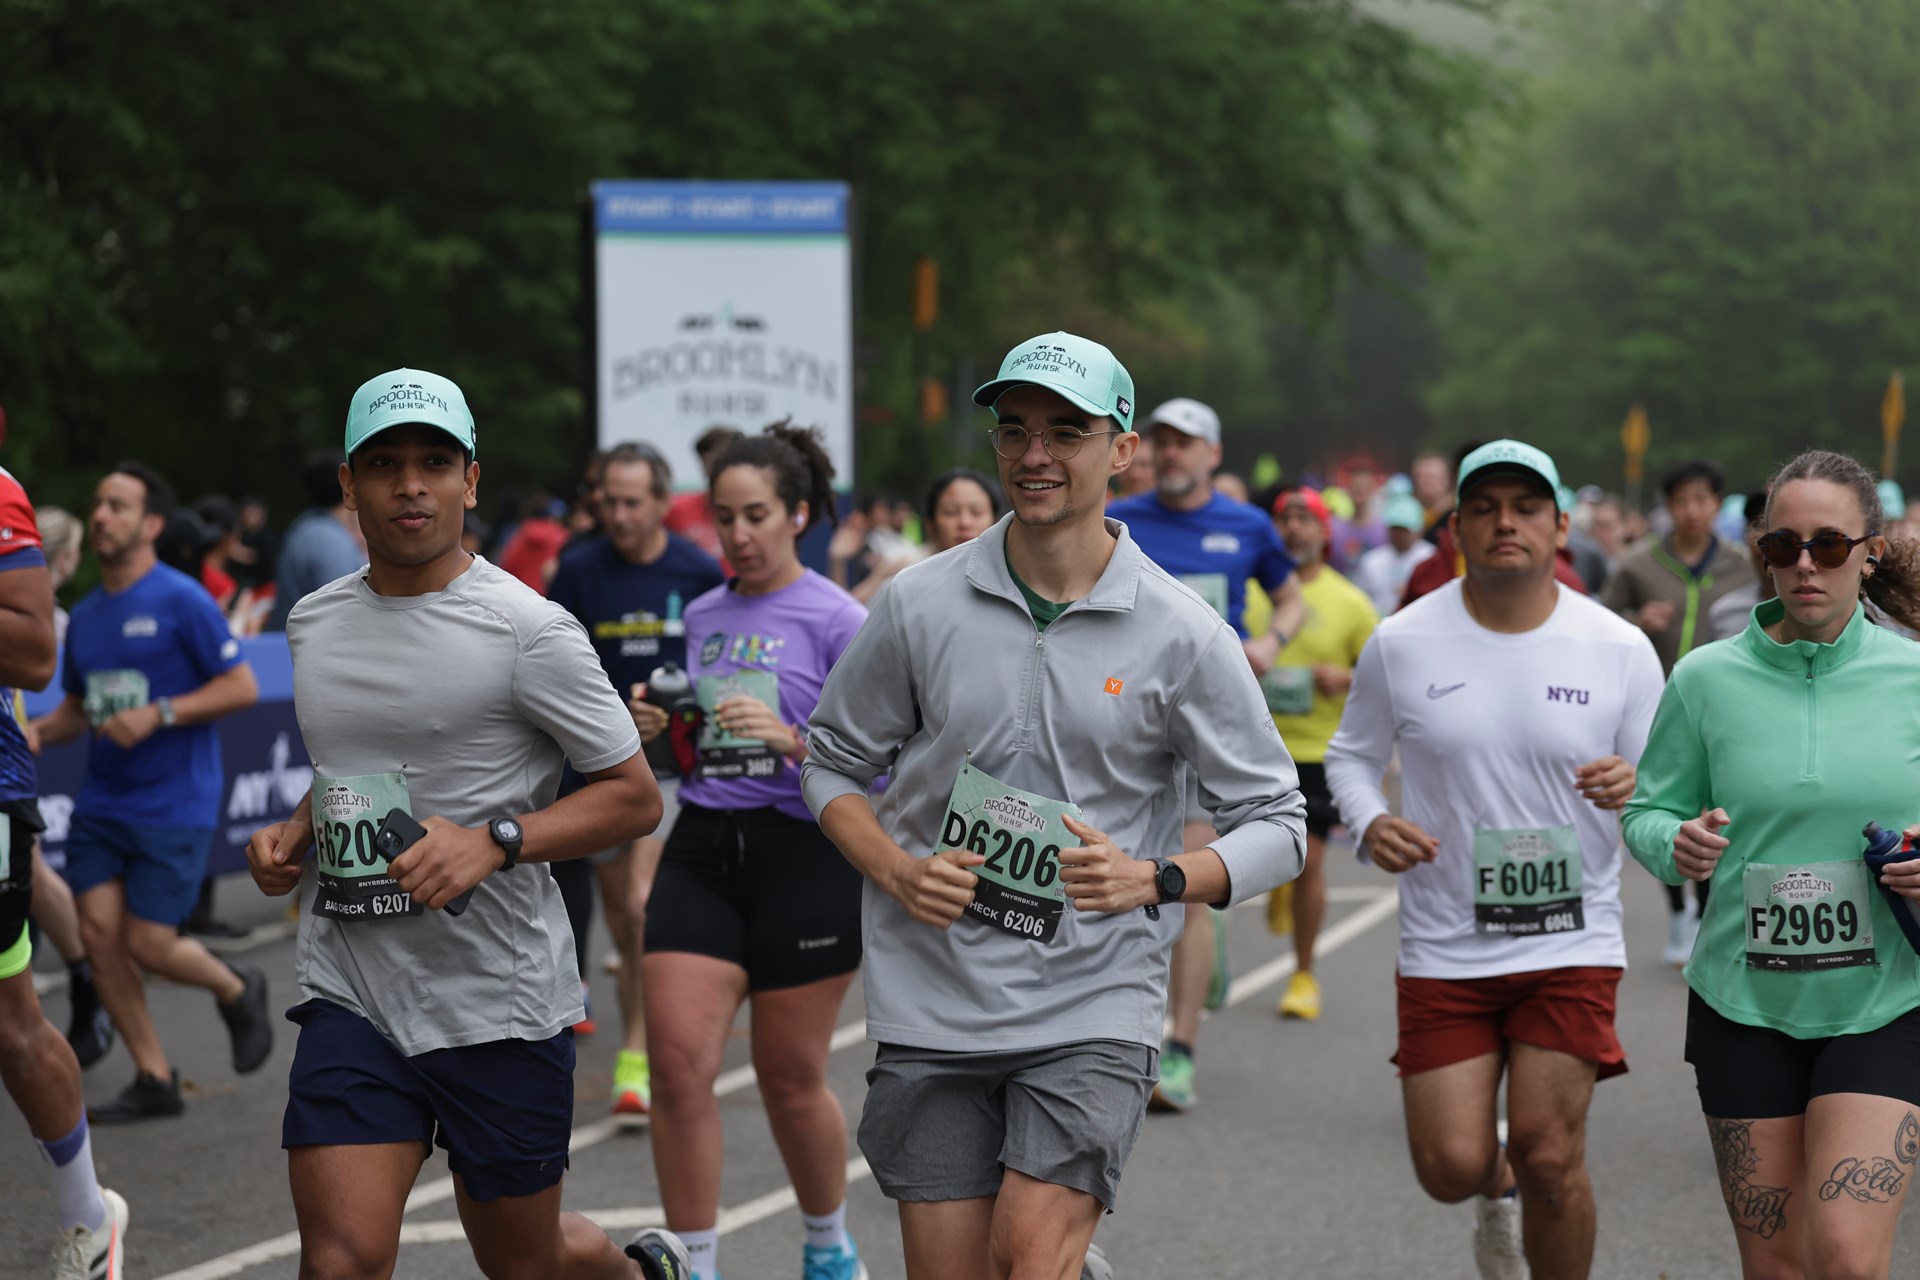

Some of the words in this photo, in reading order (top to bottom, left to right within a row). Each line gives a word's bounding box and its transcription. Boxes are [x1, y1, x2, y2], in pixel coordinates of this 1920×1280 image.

[1009, 351, 1087, 379] BROOKLYN
[368, 390, 449, 416] BROOKLYN
[1547, 686, 1589, 705] NYU
[983, 799, 1045, 831] BROOKLYN
[942, 810, 1061, 888] D6206
[1772, 879, 1832, 895] BROOKLYN
[338, 903, 366, 915] CHECK
[372, 892, 411, 915] 6207
[968, 900, 999, 920] HECK
[1003, 910, 1045, 937] 6206
[1751, 900, 1858, 946] F2969
